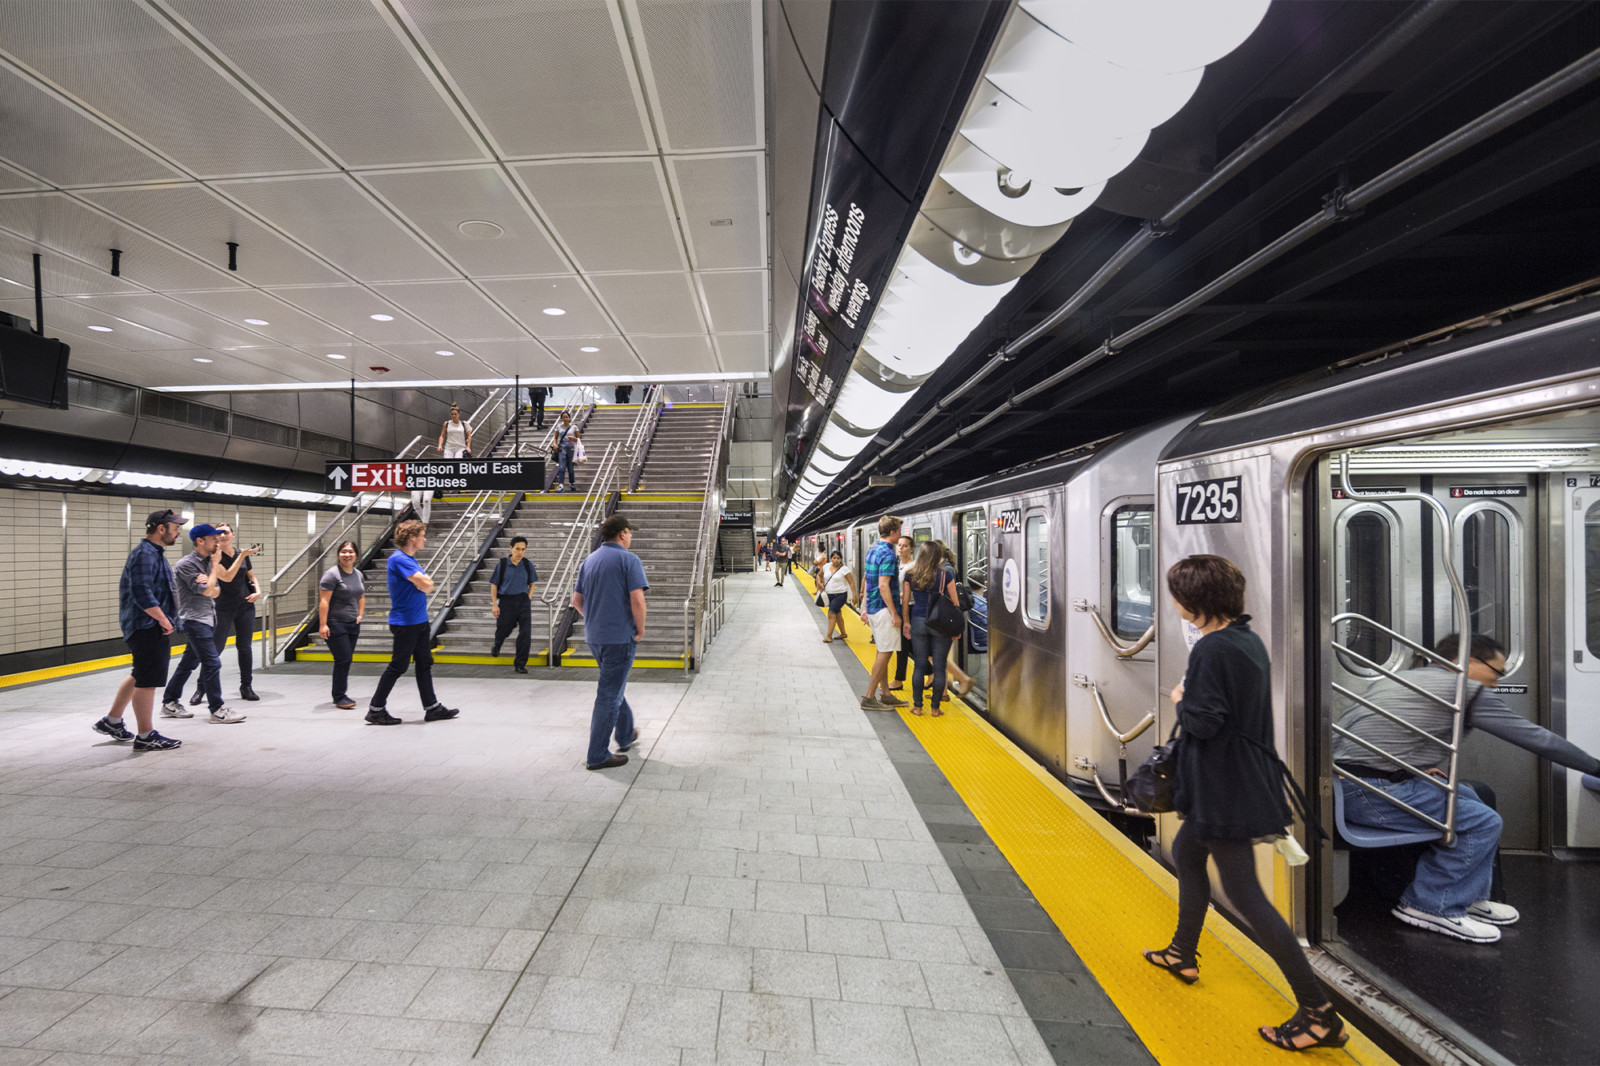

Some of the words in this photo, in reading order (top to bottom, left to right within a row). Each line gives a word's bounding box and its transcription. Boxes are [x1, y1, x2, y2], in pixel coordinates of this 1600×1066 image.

[817, 203, 839, 259] Express
[836, 202, 865, 274] afternoons
[812, 252, 832, 296] Flushing
[828, 267, 849, 312] weekday
[846, 278, 871, 321] evenings
[840, 313, 855, 329] &
[352, 464, 404, 487] Exit
[405, 463, 454, 475] Hudson
[459, 462, 487, 474] Blvd
[492, 462, 522, 474] East
[405, 476, 415, 488] &
[427, 476, 467, 488] Buses
[1002, 510, 1020, 532] 7234
[1179, 480, 1239, 521] 7235
